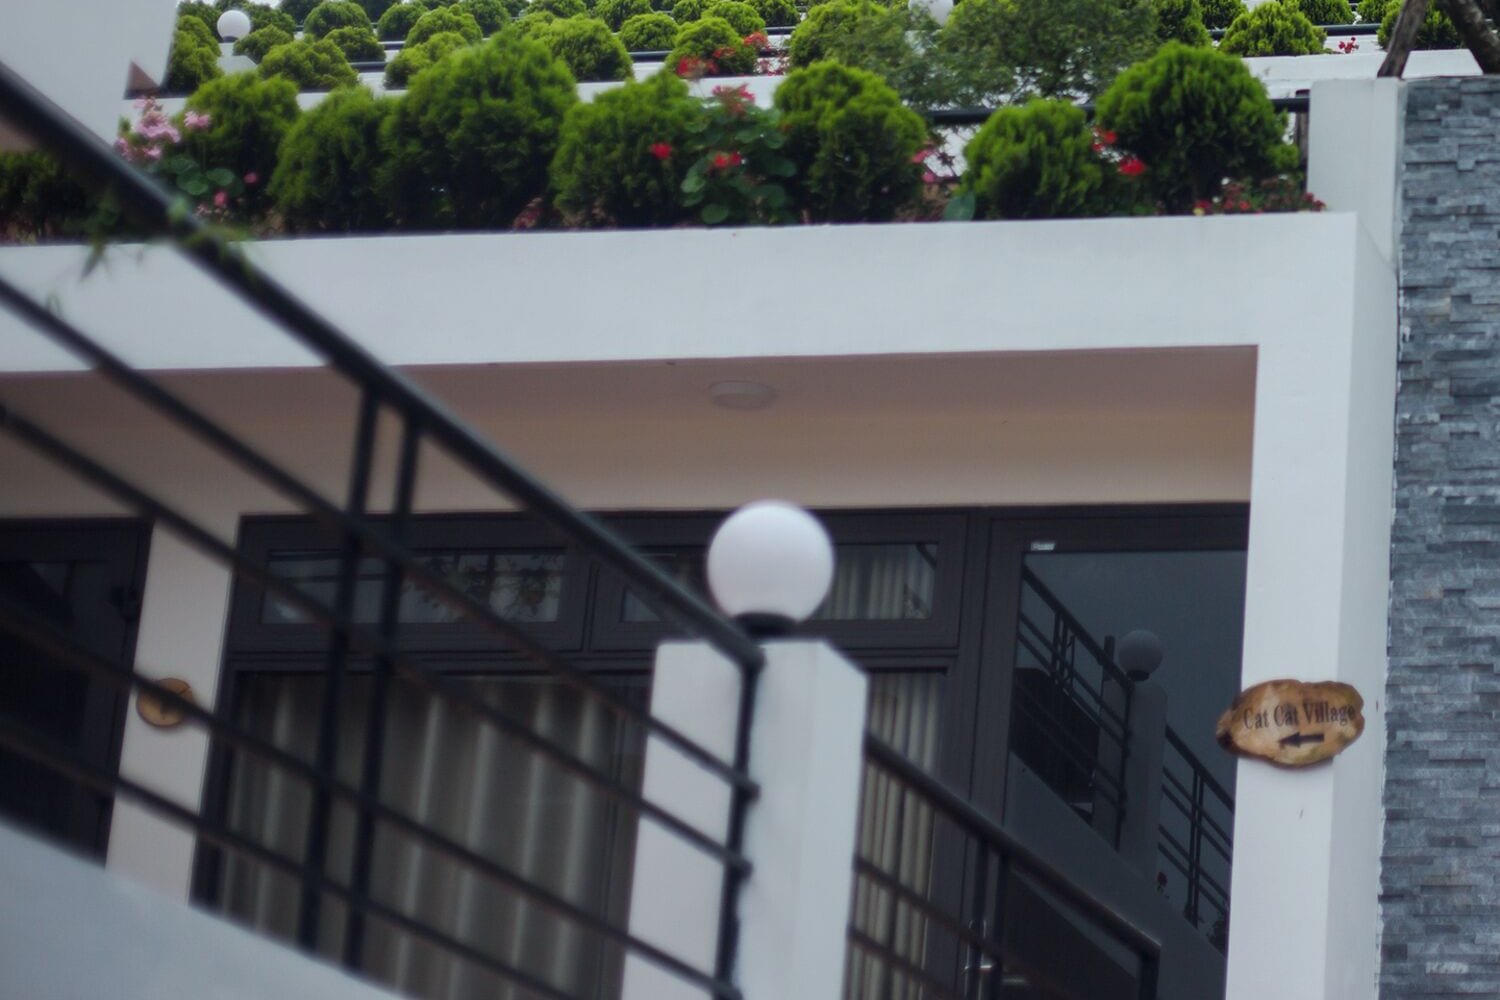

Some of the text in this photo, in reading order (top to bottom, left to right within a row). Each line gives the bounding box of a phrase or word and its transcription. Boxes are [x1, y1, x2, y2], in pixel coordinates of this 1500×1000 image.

[1244, 701, 1356, 730] Cat Cat Village
